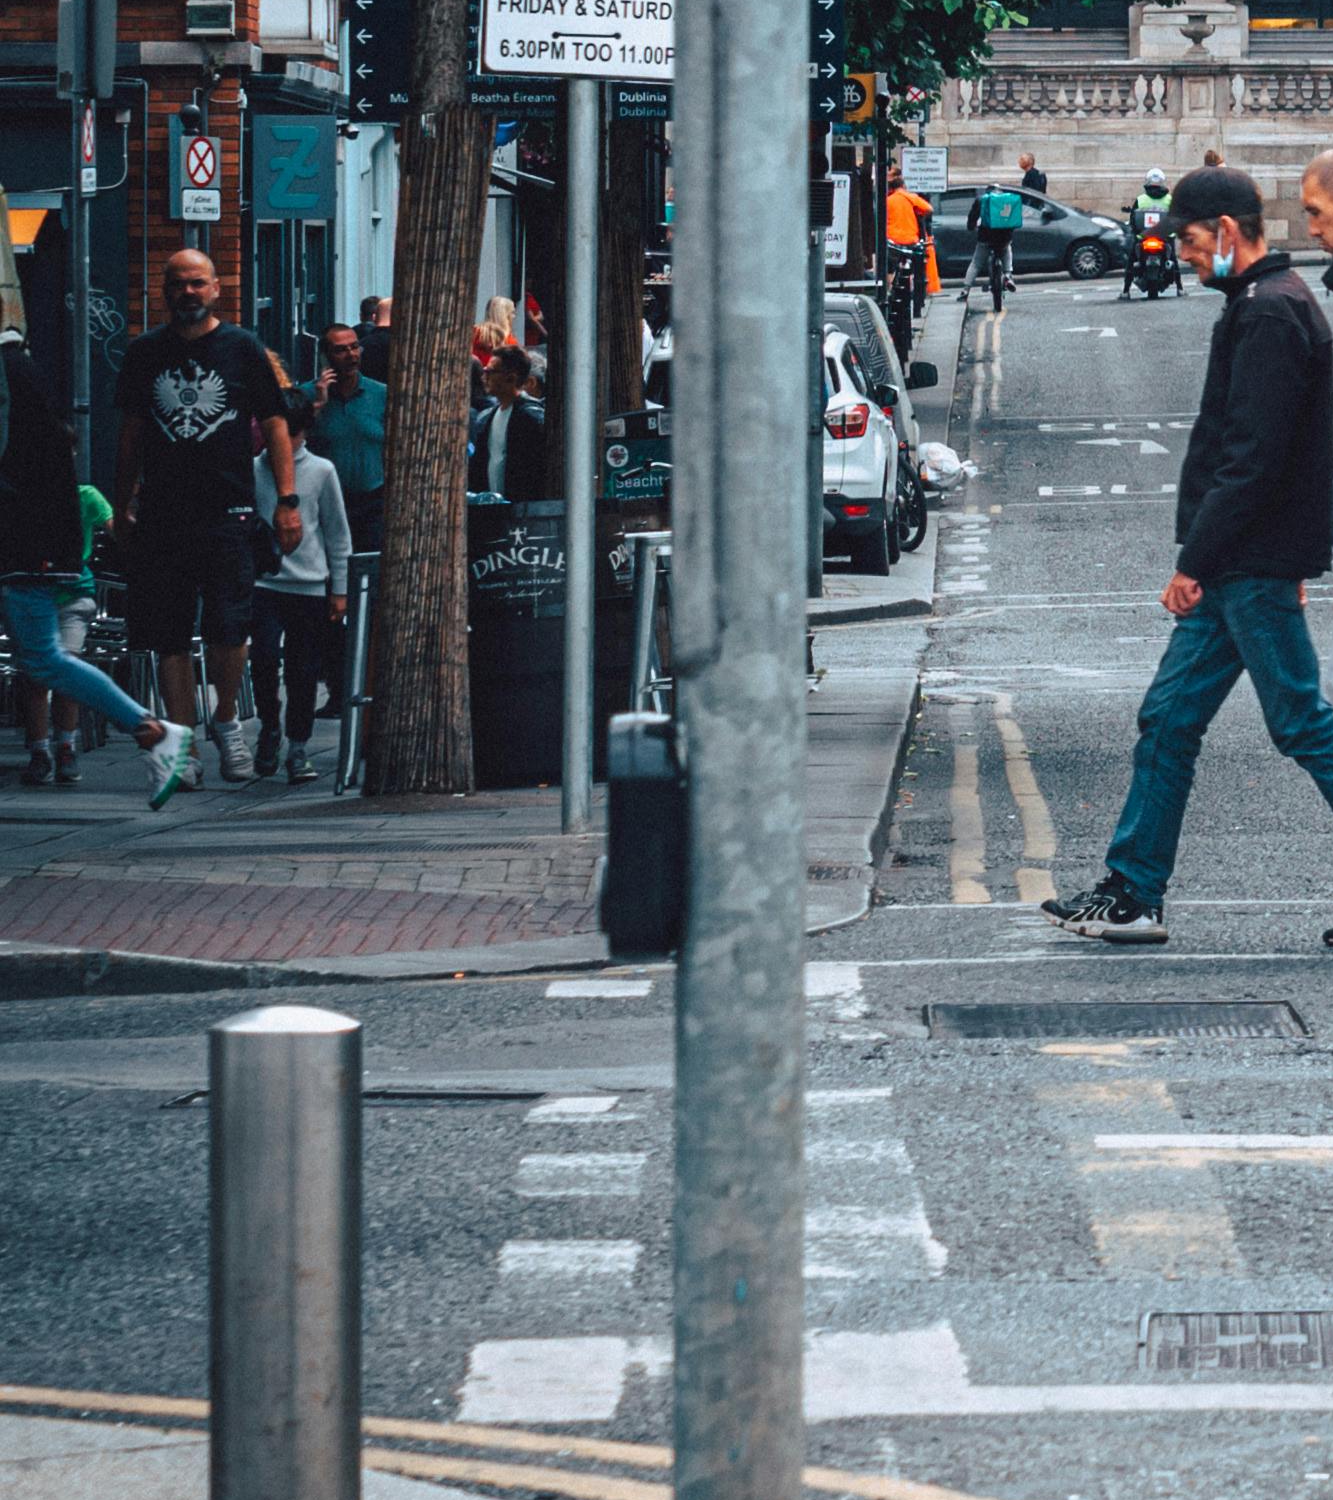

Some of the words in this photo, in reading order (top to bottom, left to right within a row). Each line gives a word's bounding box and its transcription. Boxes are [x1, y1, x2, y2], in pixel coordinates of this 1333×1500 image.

[594, 0, 675, 20] SATURD
[500, 39, 565, 60] 6.30PM
[572, 42, 612, 62] TOO
[619, 45, 675, 64] 11.00P
[471, 92, 509, 103] Beatha
